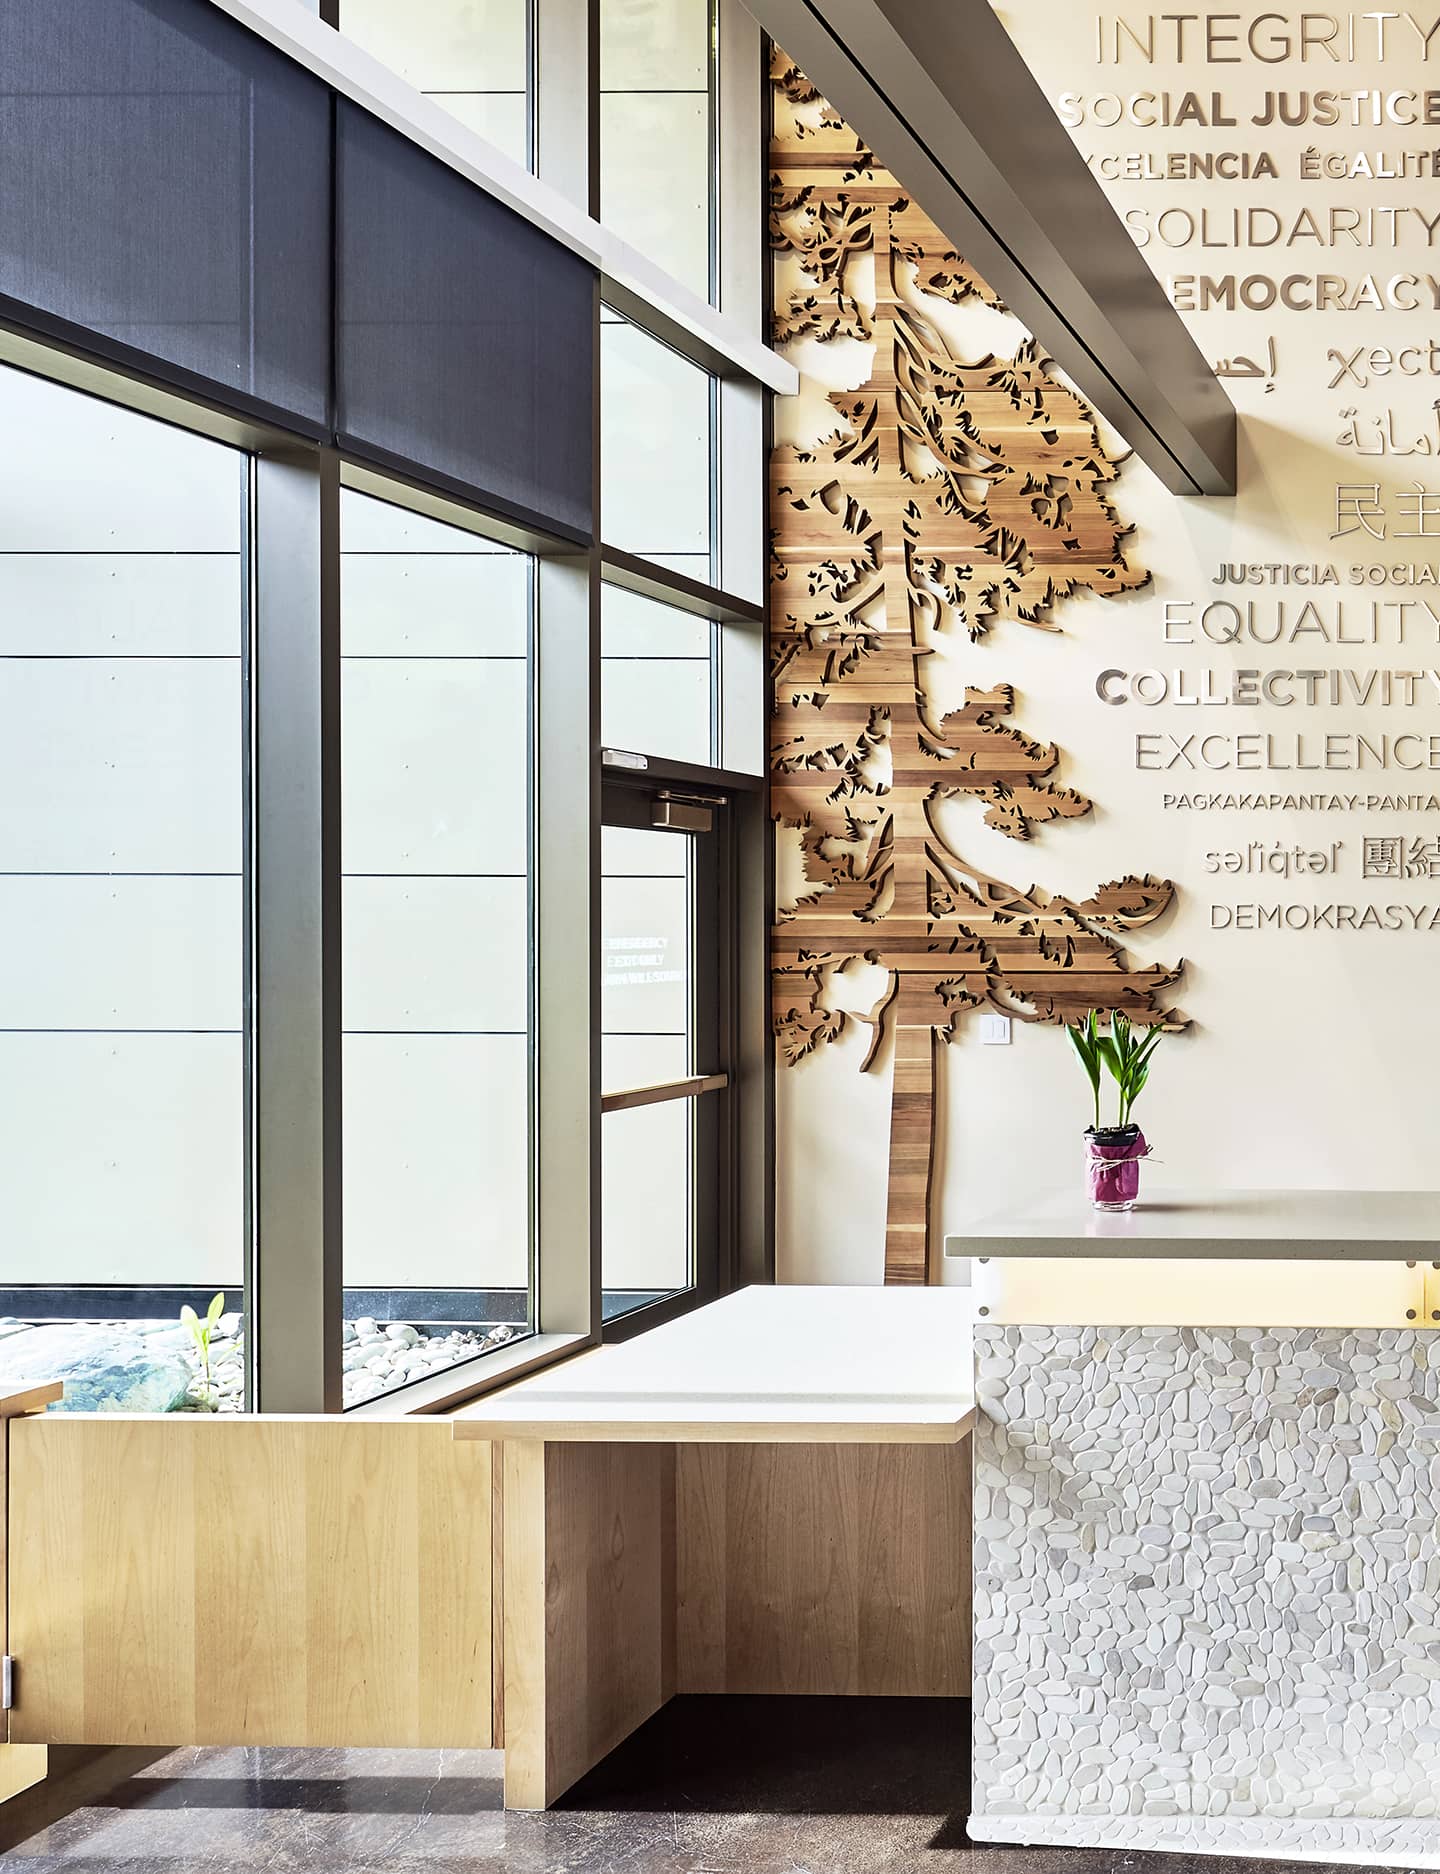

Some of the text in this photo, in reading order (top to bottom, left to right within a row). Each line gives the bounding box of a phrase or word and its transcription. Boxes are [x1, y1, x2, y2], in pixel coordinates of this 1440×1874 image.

[1057, 91, 1238, 127] SOCIAL
[1084, 151, 1280, 180] CELENCIA
[1211, 563, 1340, 586] JUSTICIA
